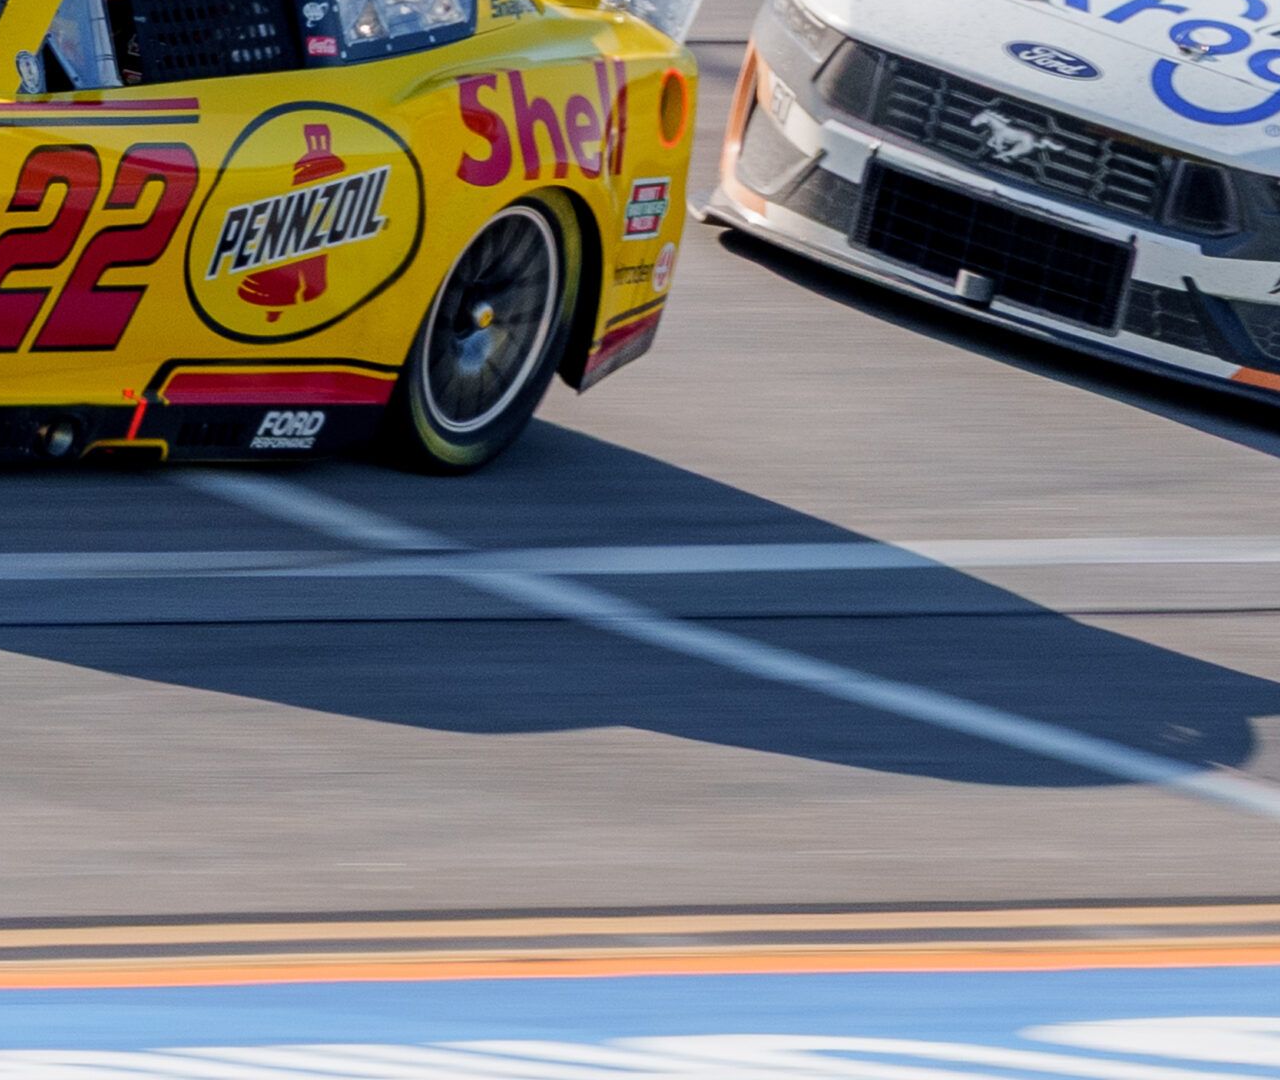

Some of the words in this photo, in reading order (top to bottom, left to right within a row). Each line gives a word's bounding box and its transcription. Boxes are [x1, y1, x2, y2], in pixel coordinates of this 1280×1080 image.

[1018, 46, 1088, 75] Ford
[455, 59, 628, 187] Shell
[206, 165, 391, 280] PENNZOIL
[257, 411, 325, 436] FORD
